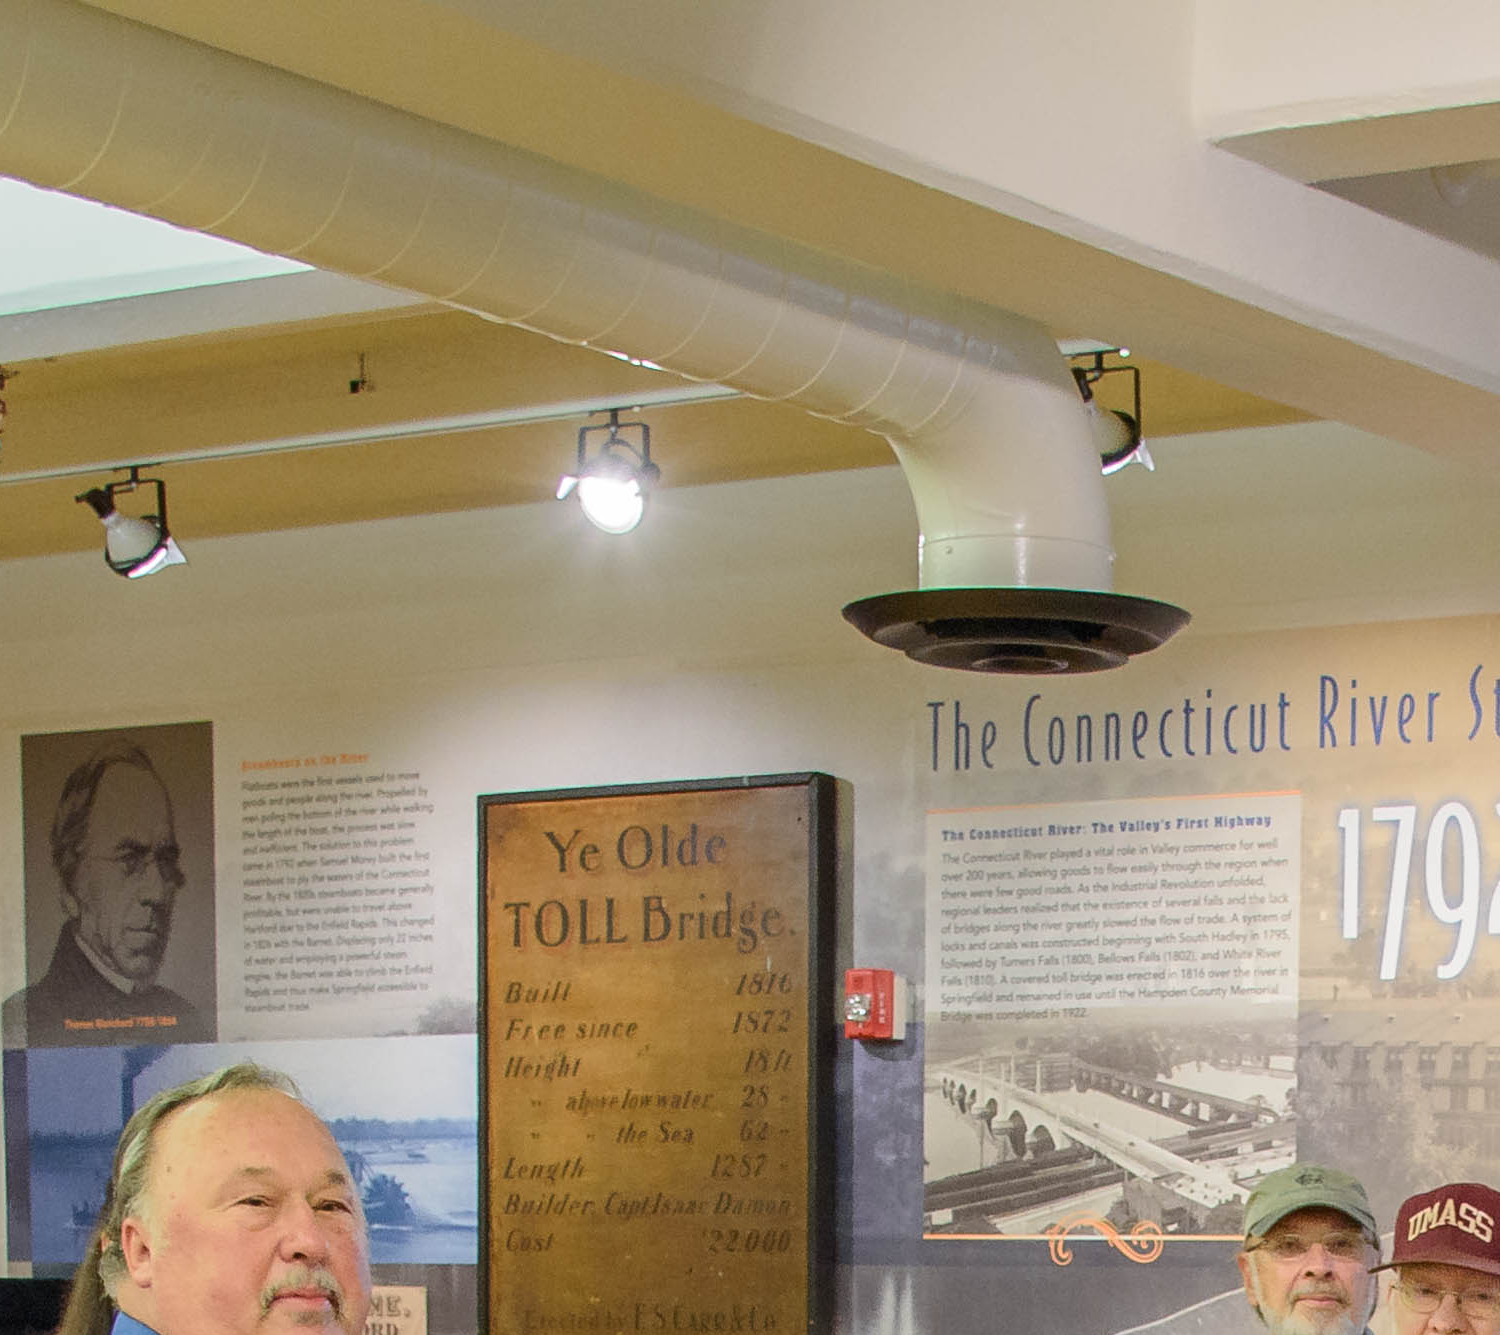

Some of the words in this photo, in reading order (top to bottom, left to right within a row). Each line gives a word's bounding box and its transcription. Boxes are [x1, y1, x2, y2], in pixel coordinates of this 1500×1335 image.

[927, 701, 997, 772] The
[1023, 689, 1291, 767] Connecticut
[1319, 674, 1441, 749] River
[942, 828, 963, 841] The
[969, 825, 1042, 840] Connecticut
[1048, 823, 1085, 837] River:
[1092, 822, 1113, 835] The
[1120, 819, 1170, 837] Valley's
[1176, 818, 1208, 831] First
[1214, 815, 1270, 833] Highway
[544, 829, 602, 873] Ye
[617, 823, 728, 870] Olde
[504, 895, 628, 948] TOLL
[505, 980, 572, 1004] Built
[735, 972, 793, 995] 1816
[505, 1019, 566, 1041] Free
[576, 1021, 639, 1041] since
[732, 1009, 792, 1034] 1872
[505, 1055, 581, 1082] Height
[616, 1122, 648, 1144] the
[659, 1120, 695, 1145] Sea
[504, 1156, 585, 1182] Length
[713, 1191, 793, 1217] Damon
[1408, 1198, 1495, 1243] UMASS
[506, 1229, 555, 1252] Cost
